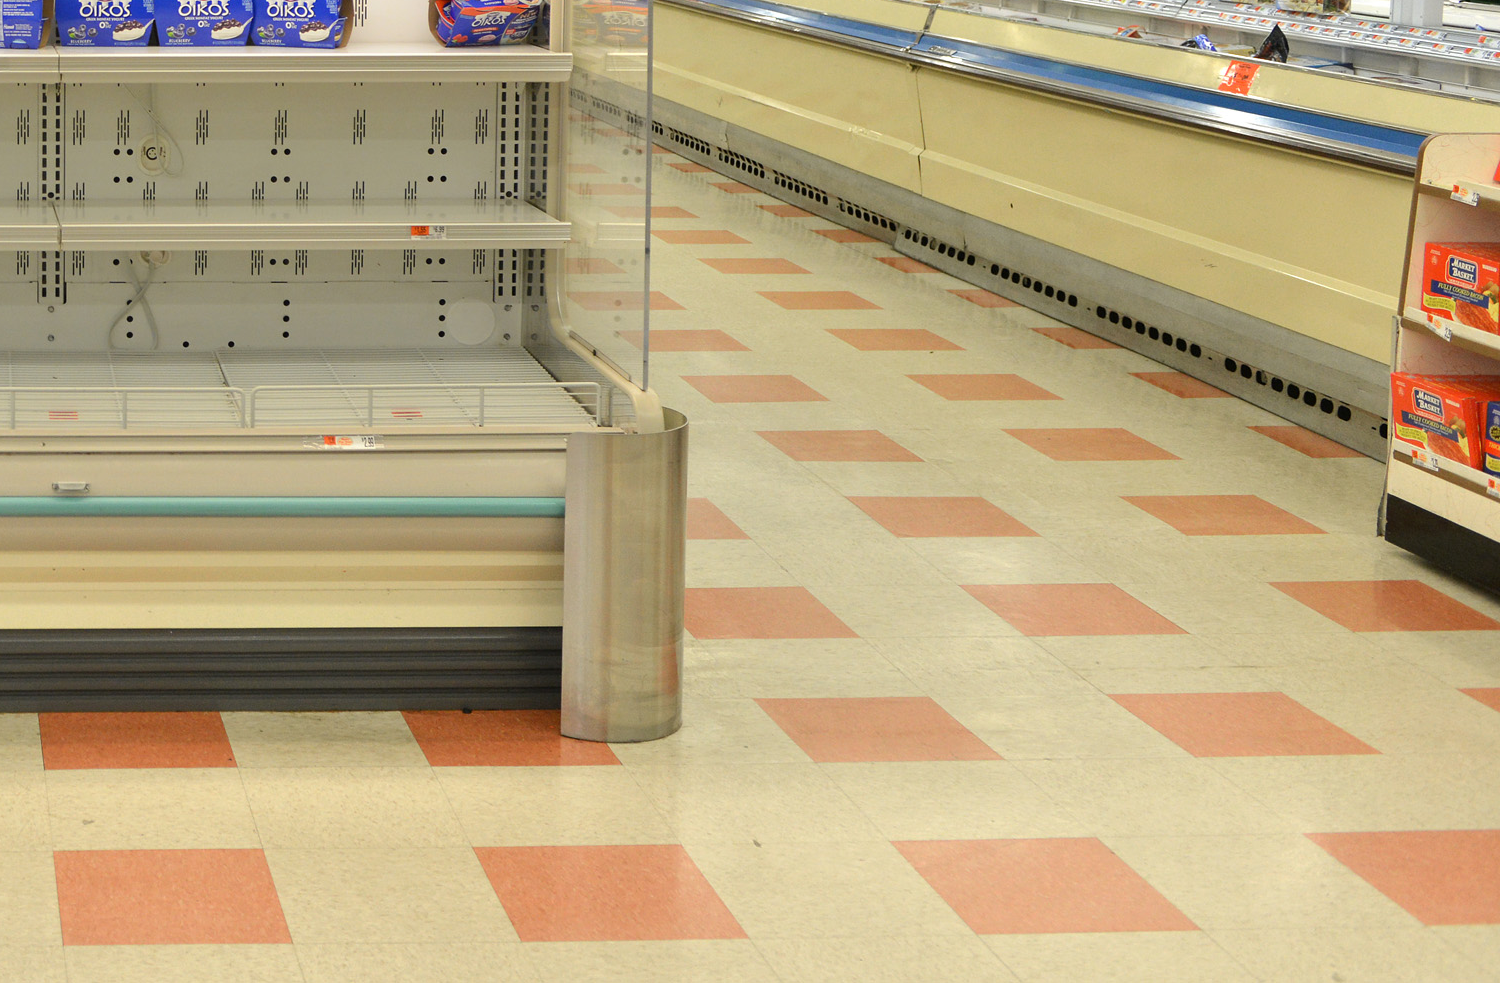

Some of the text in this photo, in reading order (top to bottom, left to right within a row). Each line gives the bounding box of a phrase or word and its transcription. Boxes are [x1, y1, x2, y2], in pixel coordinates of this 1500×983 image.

[79, 4, 131, 18] OIKOS
[178, 3, 230, 17] OIKOS
[266, 4, 316, 18] OIKOS
[471, 16, 506, 27] OIKOS
[1451, 258, 1475, 272] MARKET
[1452, 267, 1474, 281] BASKET
[1417, 391, 1440, 405] MARKET
[1418, 400, 1441, 413] BASKET
